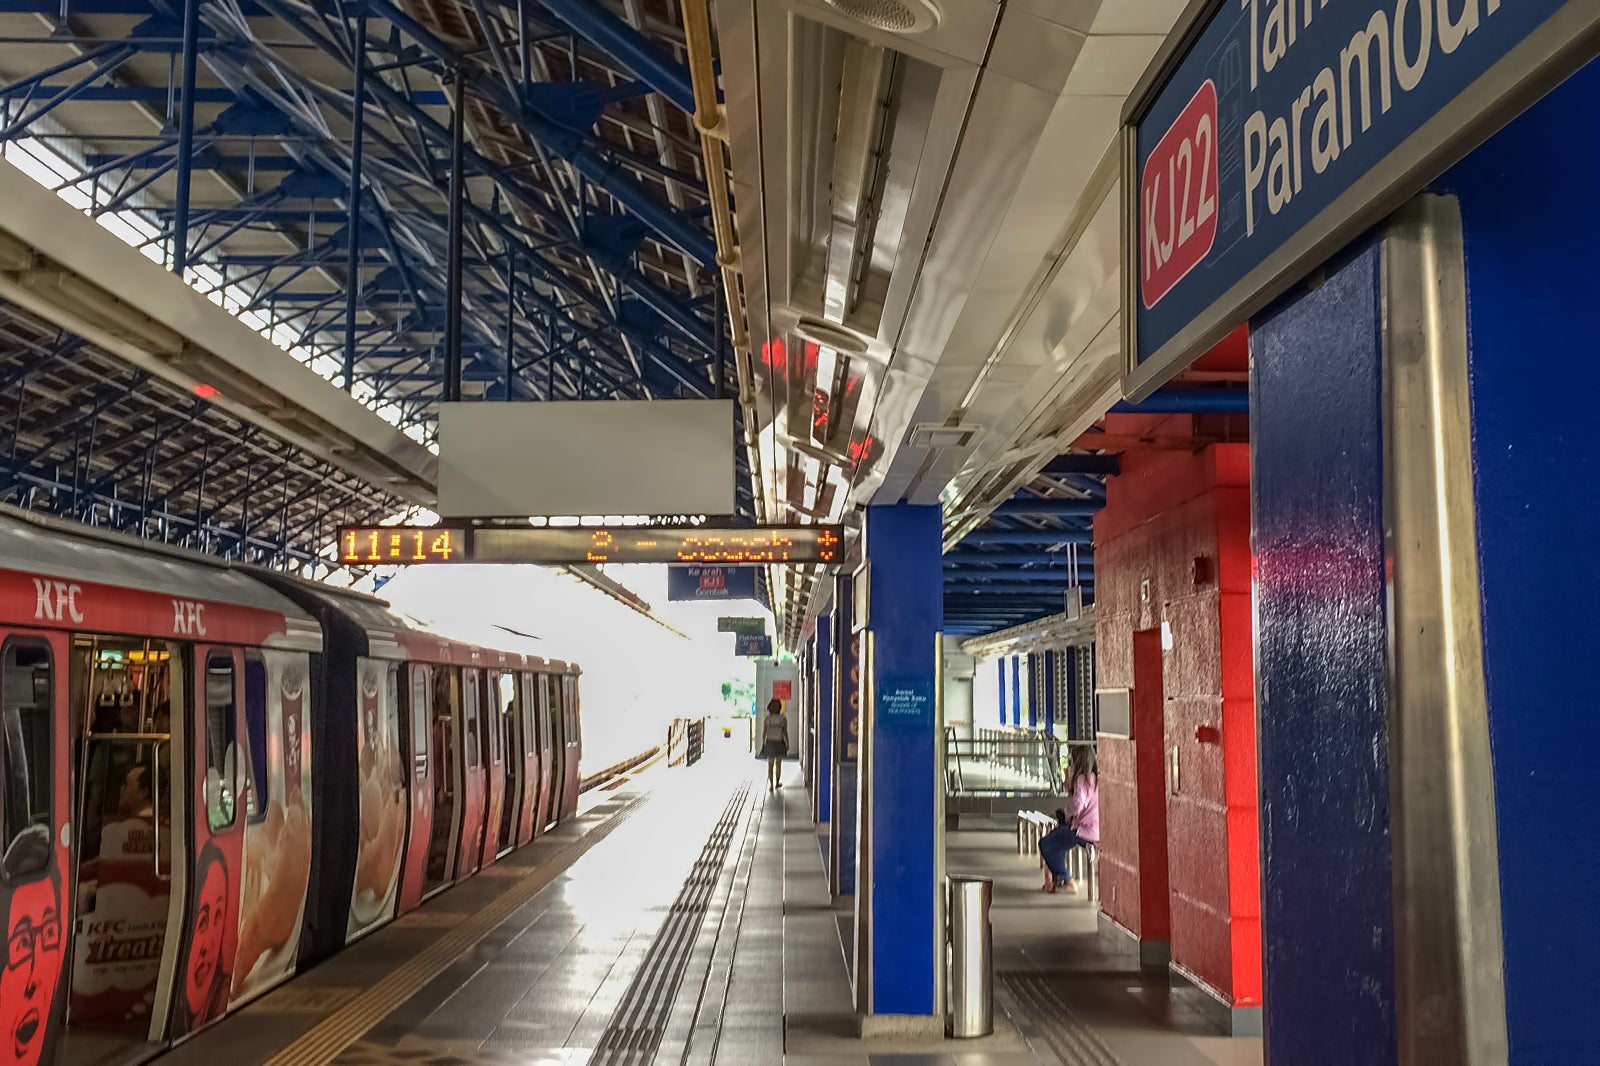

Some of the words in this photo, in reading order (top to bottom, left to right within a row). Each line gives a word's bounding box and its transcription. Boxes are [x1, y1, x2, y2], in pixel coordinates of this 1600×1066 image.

[1244, 0, 1502, 238] Paramo
[1144, 113, 1216, 282] KJ22
[344, 530, 453, 561] 11:14
[702, 567, 722, 576] arah
[33, 577, 84, 624] KFC
[695, 587, 730, 597] Gombak
[172, 599, 207, 637] KFC
[88, 920, 124, 935] KFC
